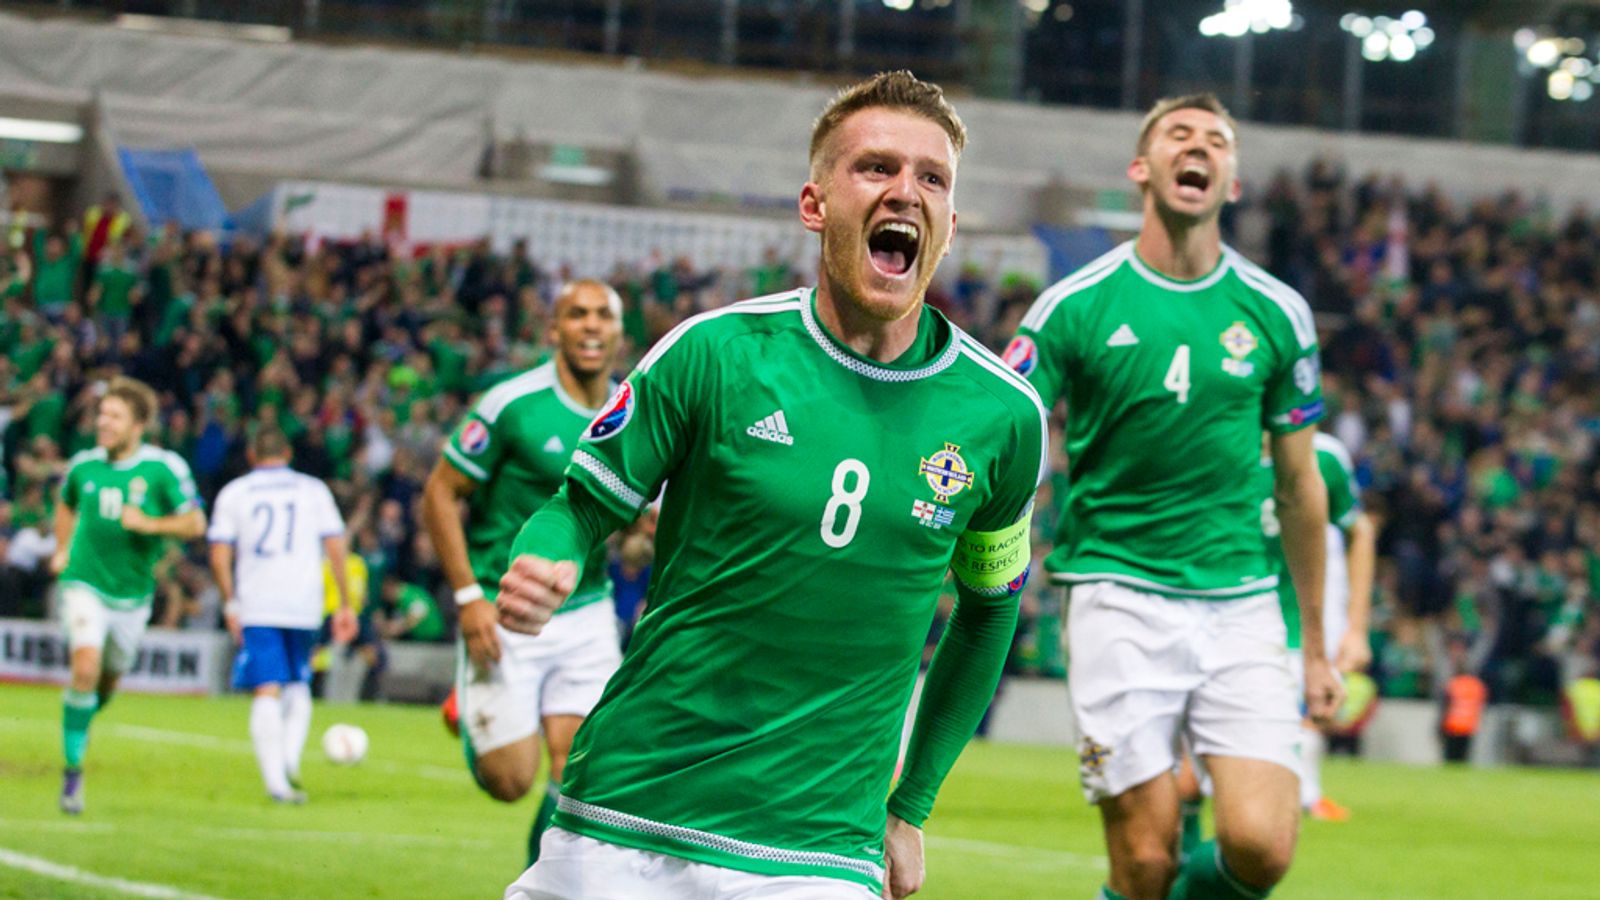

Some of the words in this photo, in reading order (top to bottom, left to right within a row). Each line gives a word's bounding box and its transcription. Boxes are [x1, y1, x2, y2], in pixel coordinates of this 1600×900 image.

[1163, 344, 1191, 404] 4
[746, 426, 794, 446] adidas
[820, 458, 870, 549] 8
[251, 501, 297, 558] 21
[968, 543, 986, 553] TO
[971, 549, 1019, 571] RESPECT
